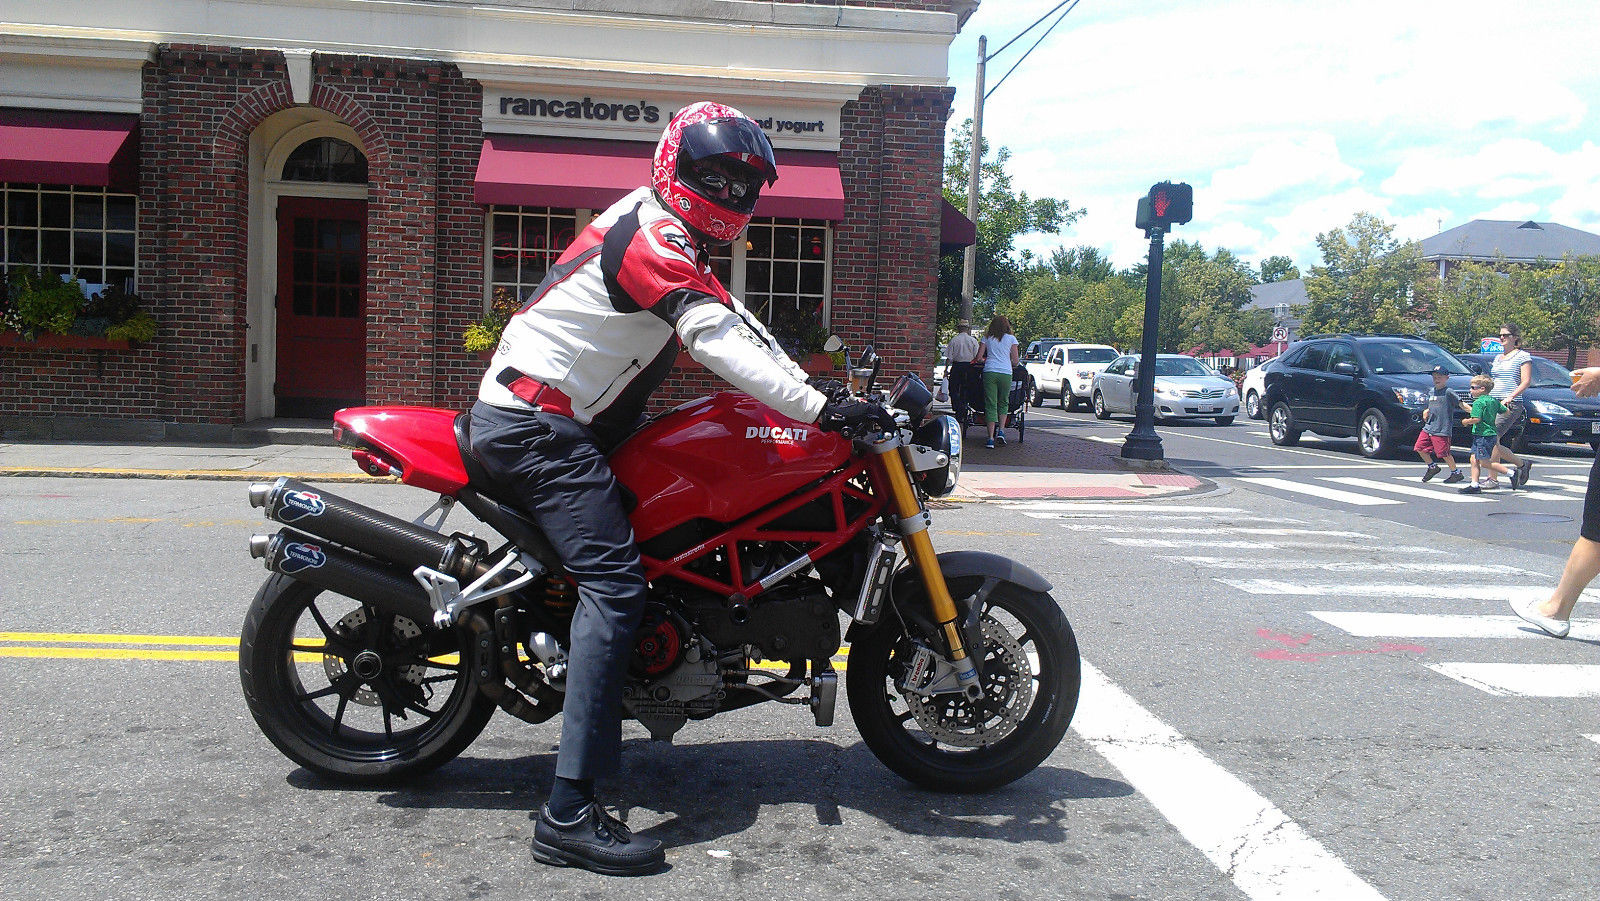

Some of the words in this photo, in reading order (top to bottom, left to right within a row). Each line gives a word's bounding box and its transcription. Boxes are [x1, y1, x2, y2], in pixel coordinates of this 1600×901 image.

[500, 96, 660, 123] rancatore's
[754, 117, 773, 130] nd
[776, 120, 825, 134] yogurt
[745, 426, 808, 441] DUCATI
